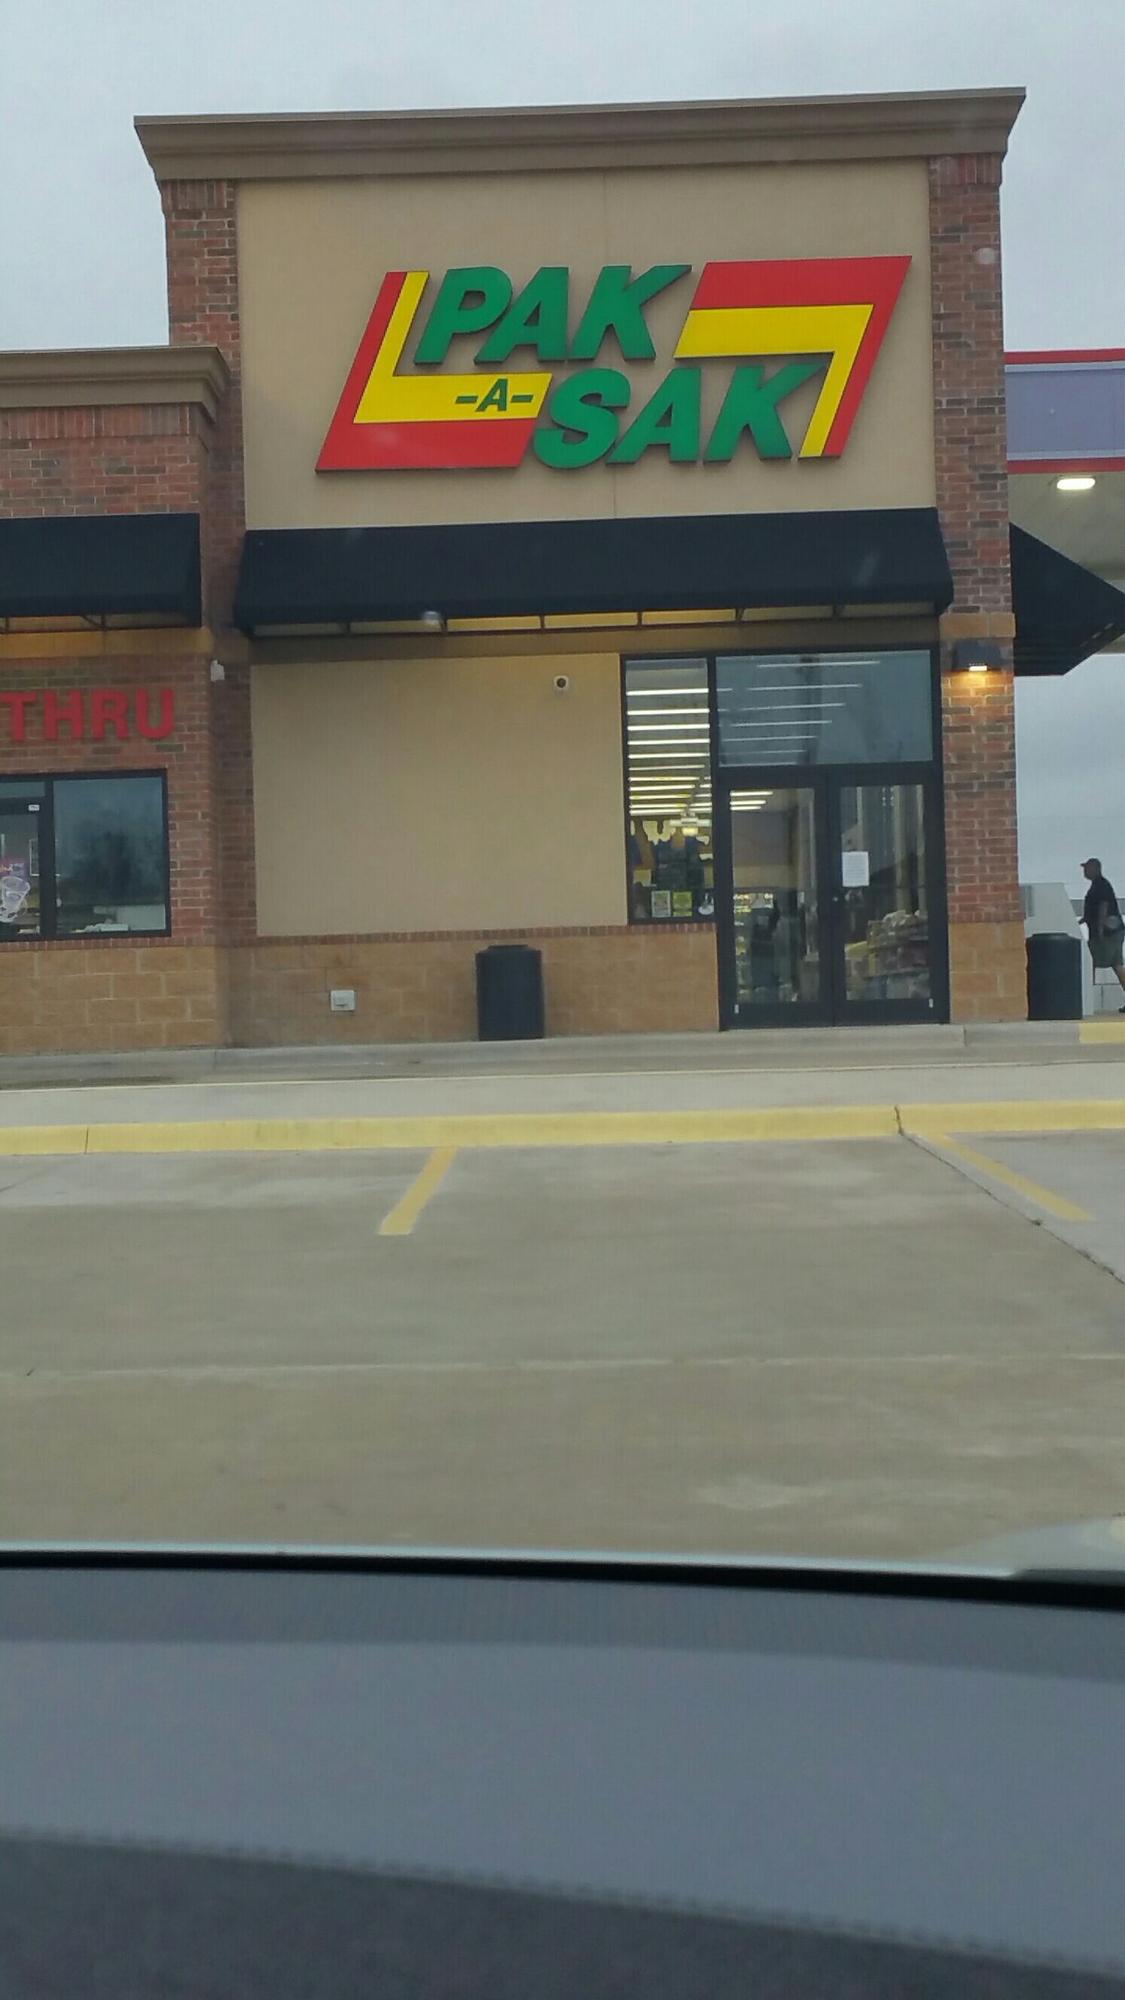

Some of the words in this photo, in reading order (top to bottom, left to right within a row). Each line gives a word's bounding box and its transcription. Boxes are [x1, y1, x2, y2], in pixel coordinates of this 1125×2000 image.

[414, 265, 693, 364] PAK
[534, 364, 828, 469] SAK
[0, 688, 175, 742] THRU
